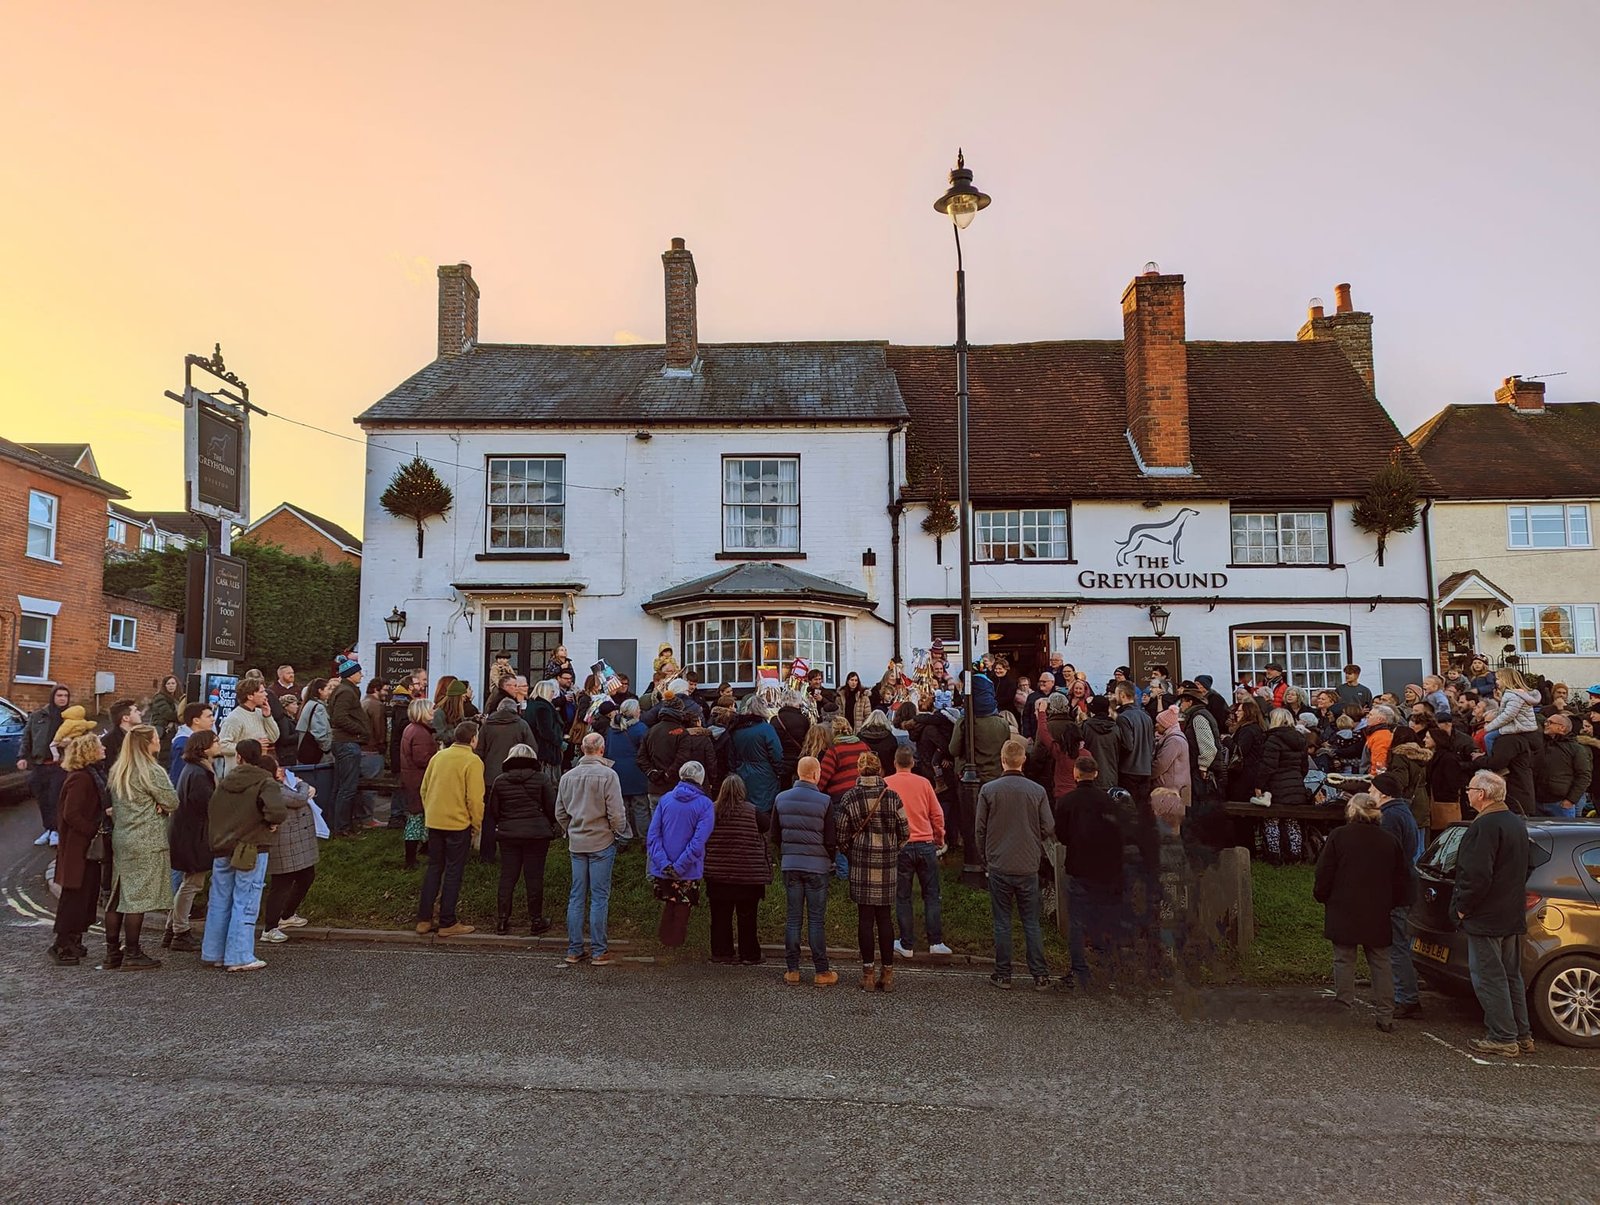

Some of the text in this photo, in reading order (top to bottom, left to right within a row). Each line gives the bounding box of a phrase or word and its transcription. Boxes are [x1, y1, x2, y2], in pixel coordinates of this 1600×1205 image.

[199, 454, 235, 475] GREYHOUND
[1134, 555, 1169, 569] THE
[215, 576, 240, 590] CASK ALES
[1078, 570, 1227, 588] GREYHOUND
[220, 606, 235, 617] FOOD
[215, 636, 236, 647] GARDEN
[218, 699, 236, 708] WORLD
